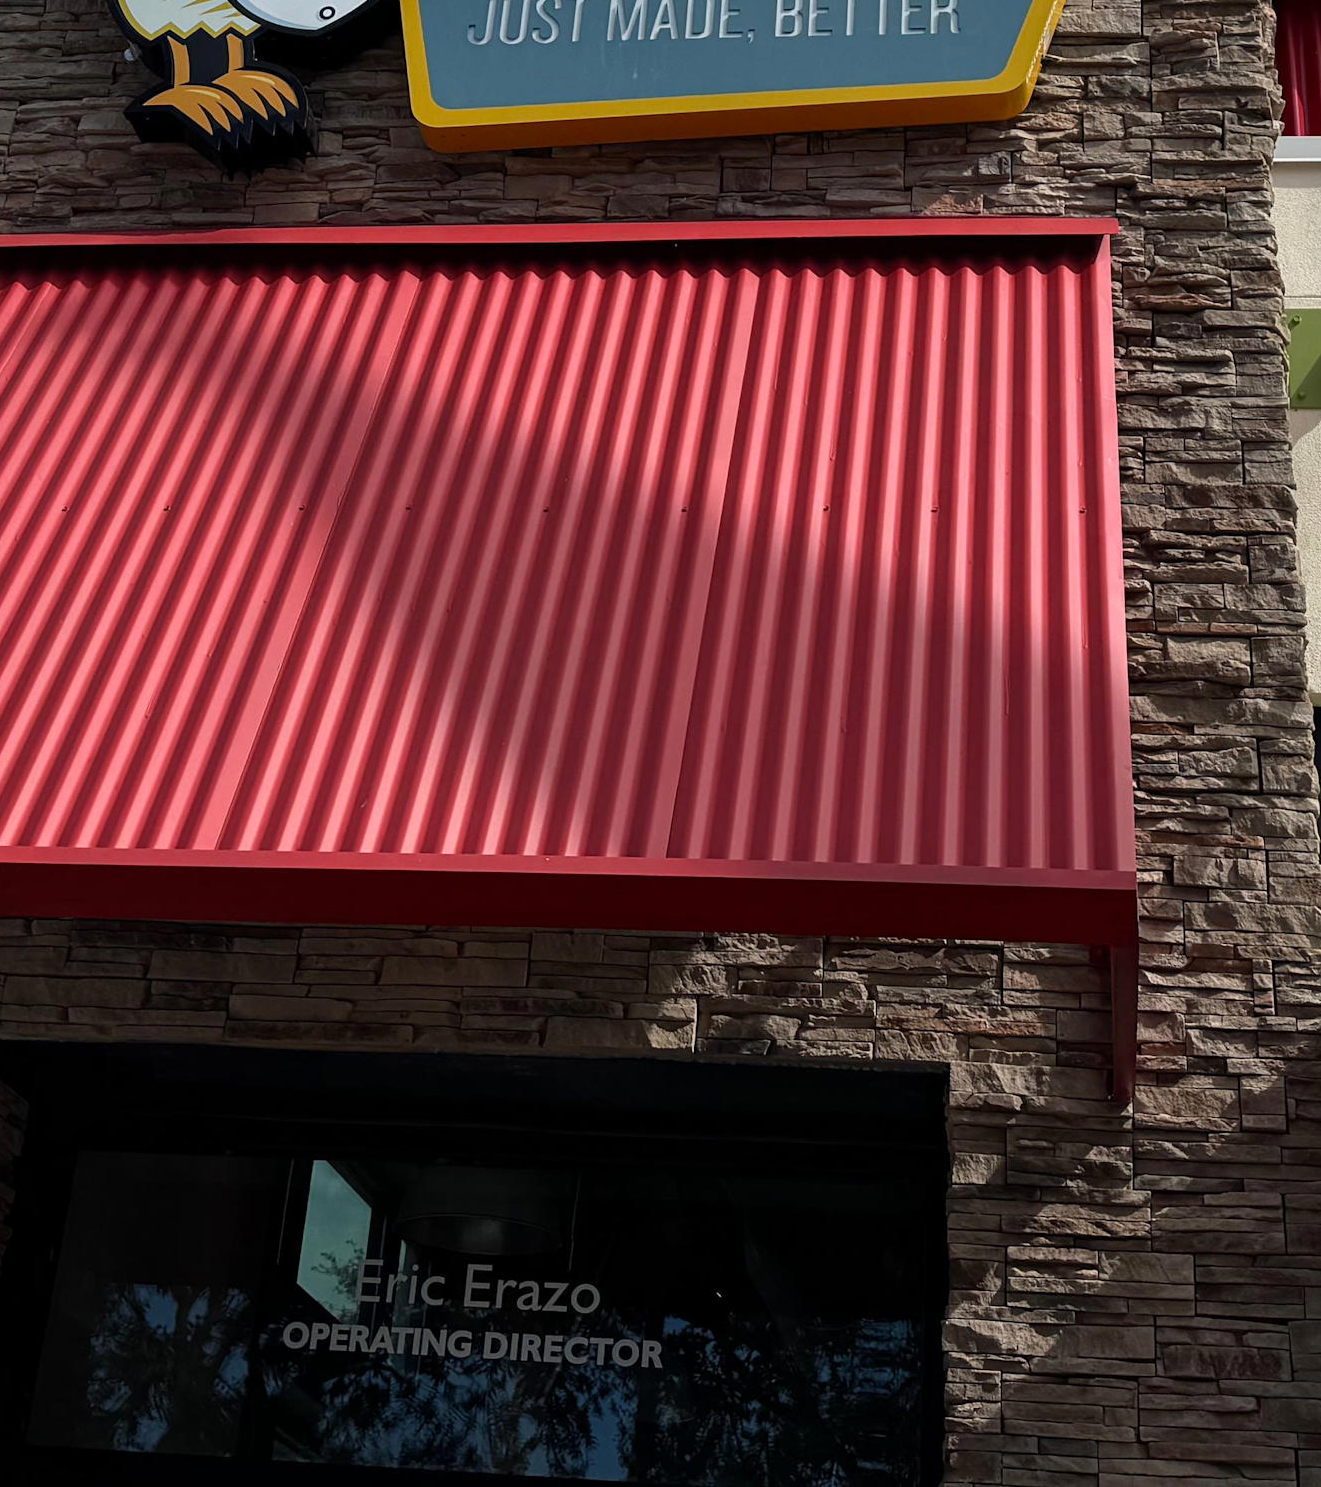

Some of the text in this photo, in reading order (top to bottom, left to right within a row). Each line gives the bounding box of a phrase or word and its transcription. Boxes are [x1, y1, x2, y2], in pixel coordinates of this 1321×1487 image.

[356, 1259, 601, 1314] Eric Erazo
[282, 1321, 663, 1369] OPERATING DIRECTOR
